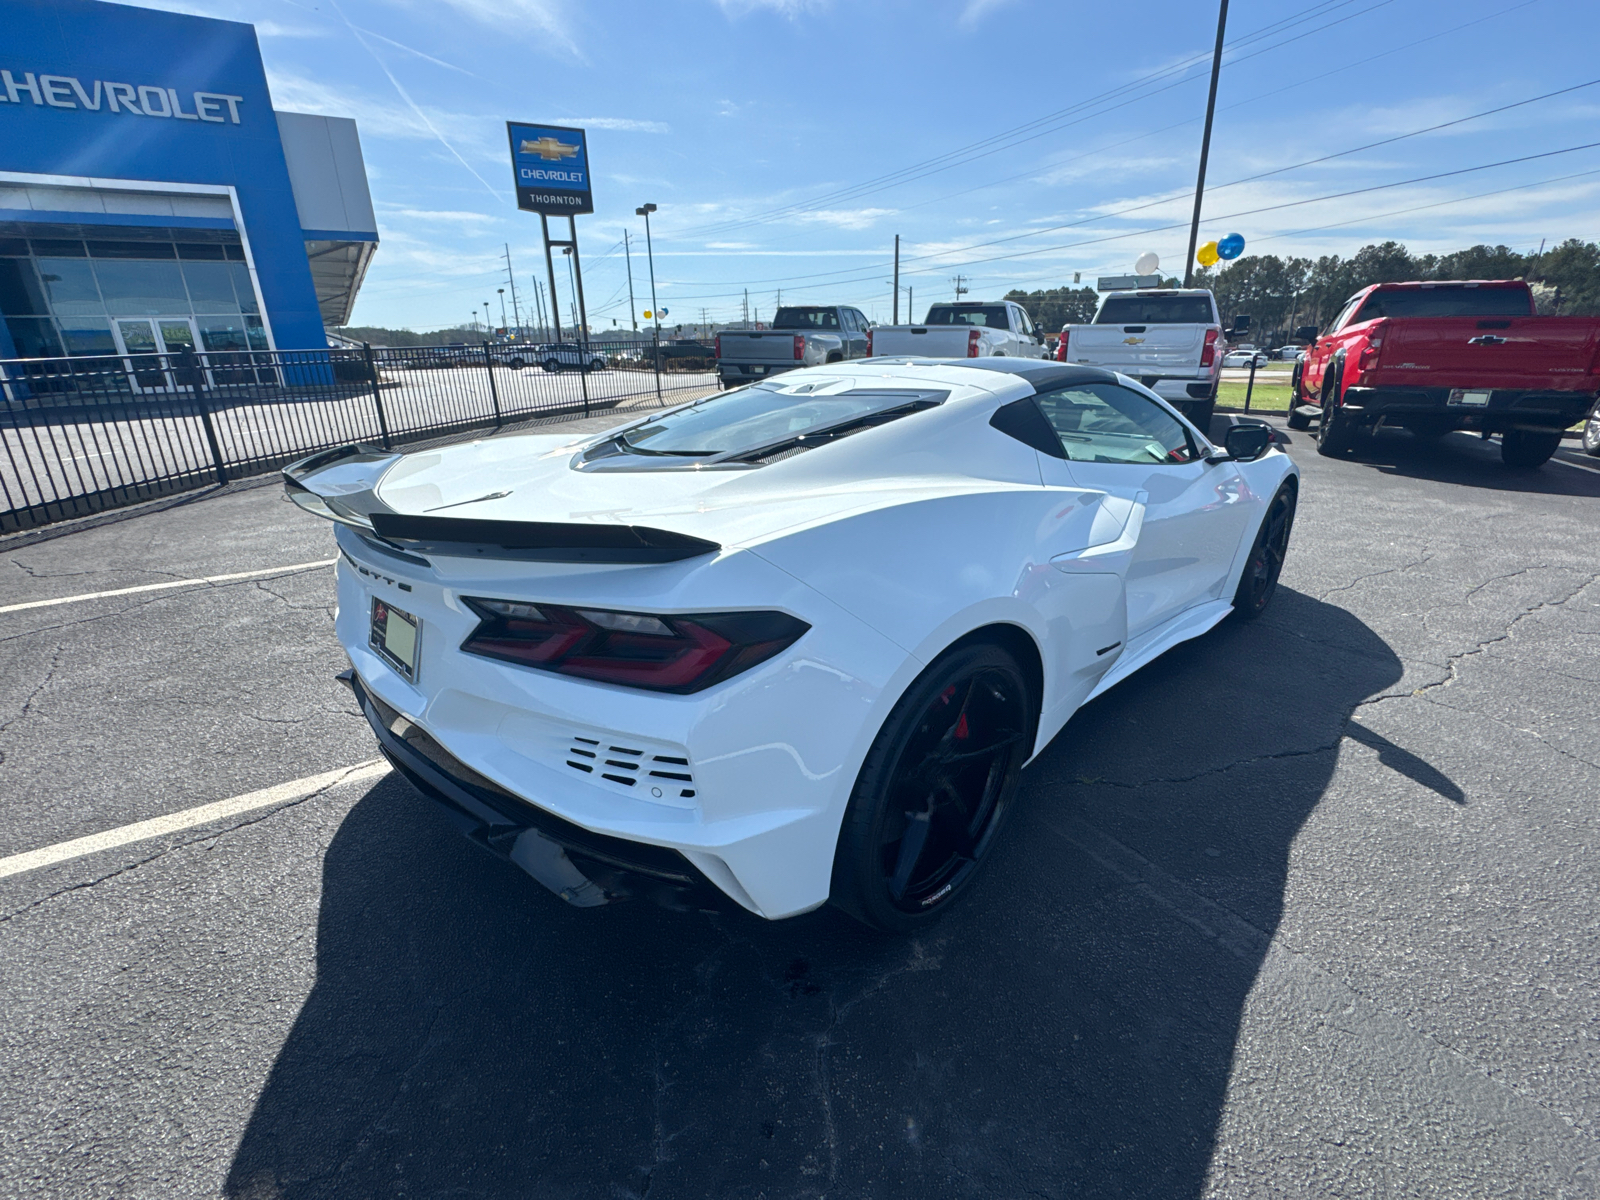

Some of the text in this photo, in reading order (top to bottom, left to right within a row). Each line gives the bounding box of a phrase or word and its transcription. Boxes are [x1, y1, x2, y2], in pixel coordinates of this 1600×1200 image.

[0, 69, 243, 124] HEVROLET
[521, 168, 583, 182] CHEVROLET
[529, 194, 582, 205] THORNTON
